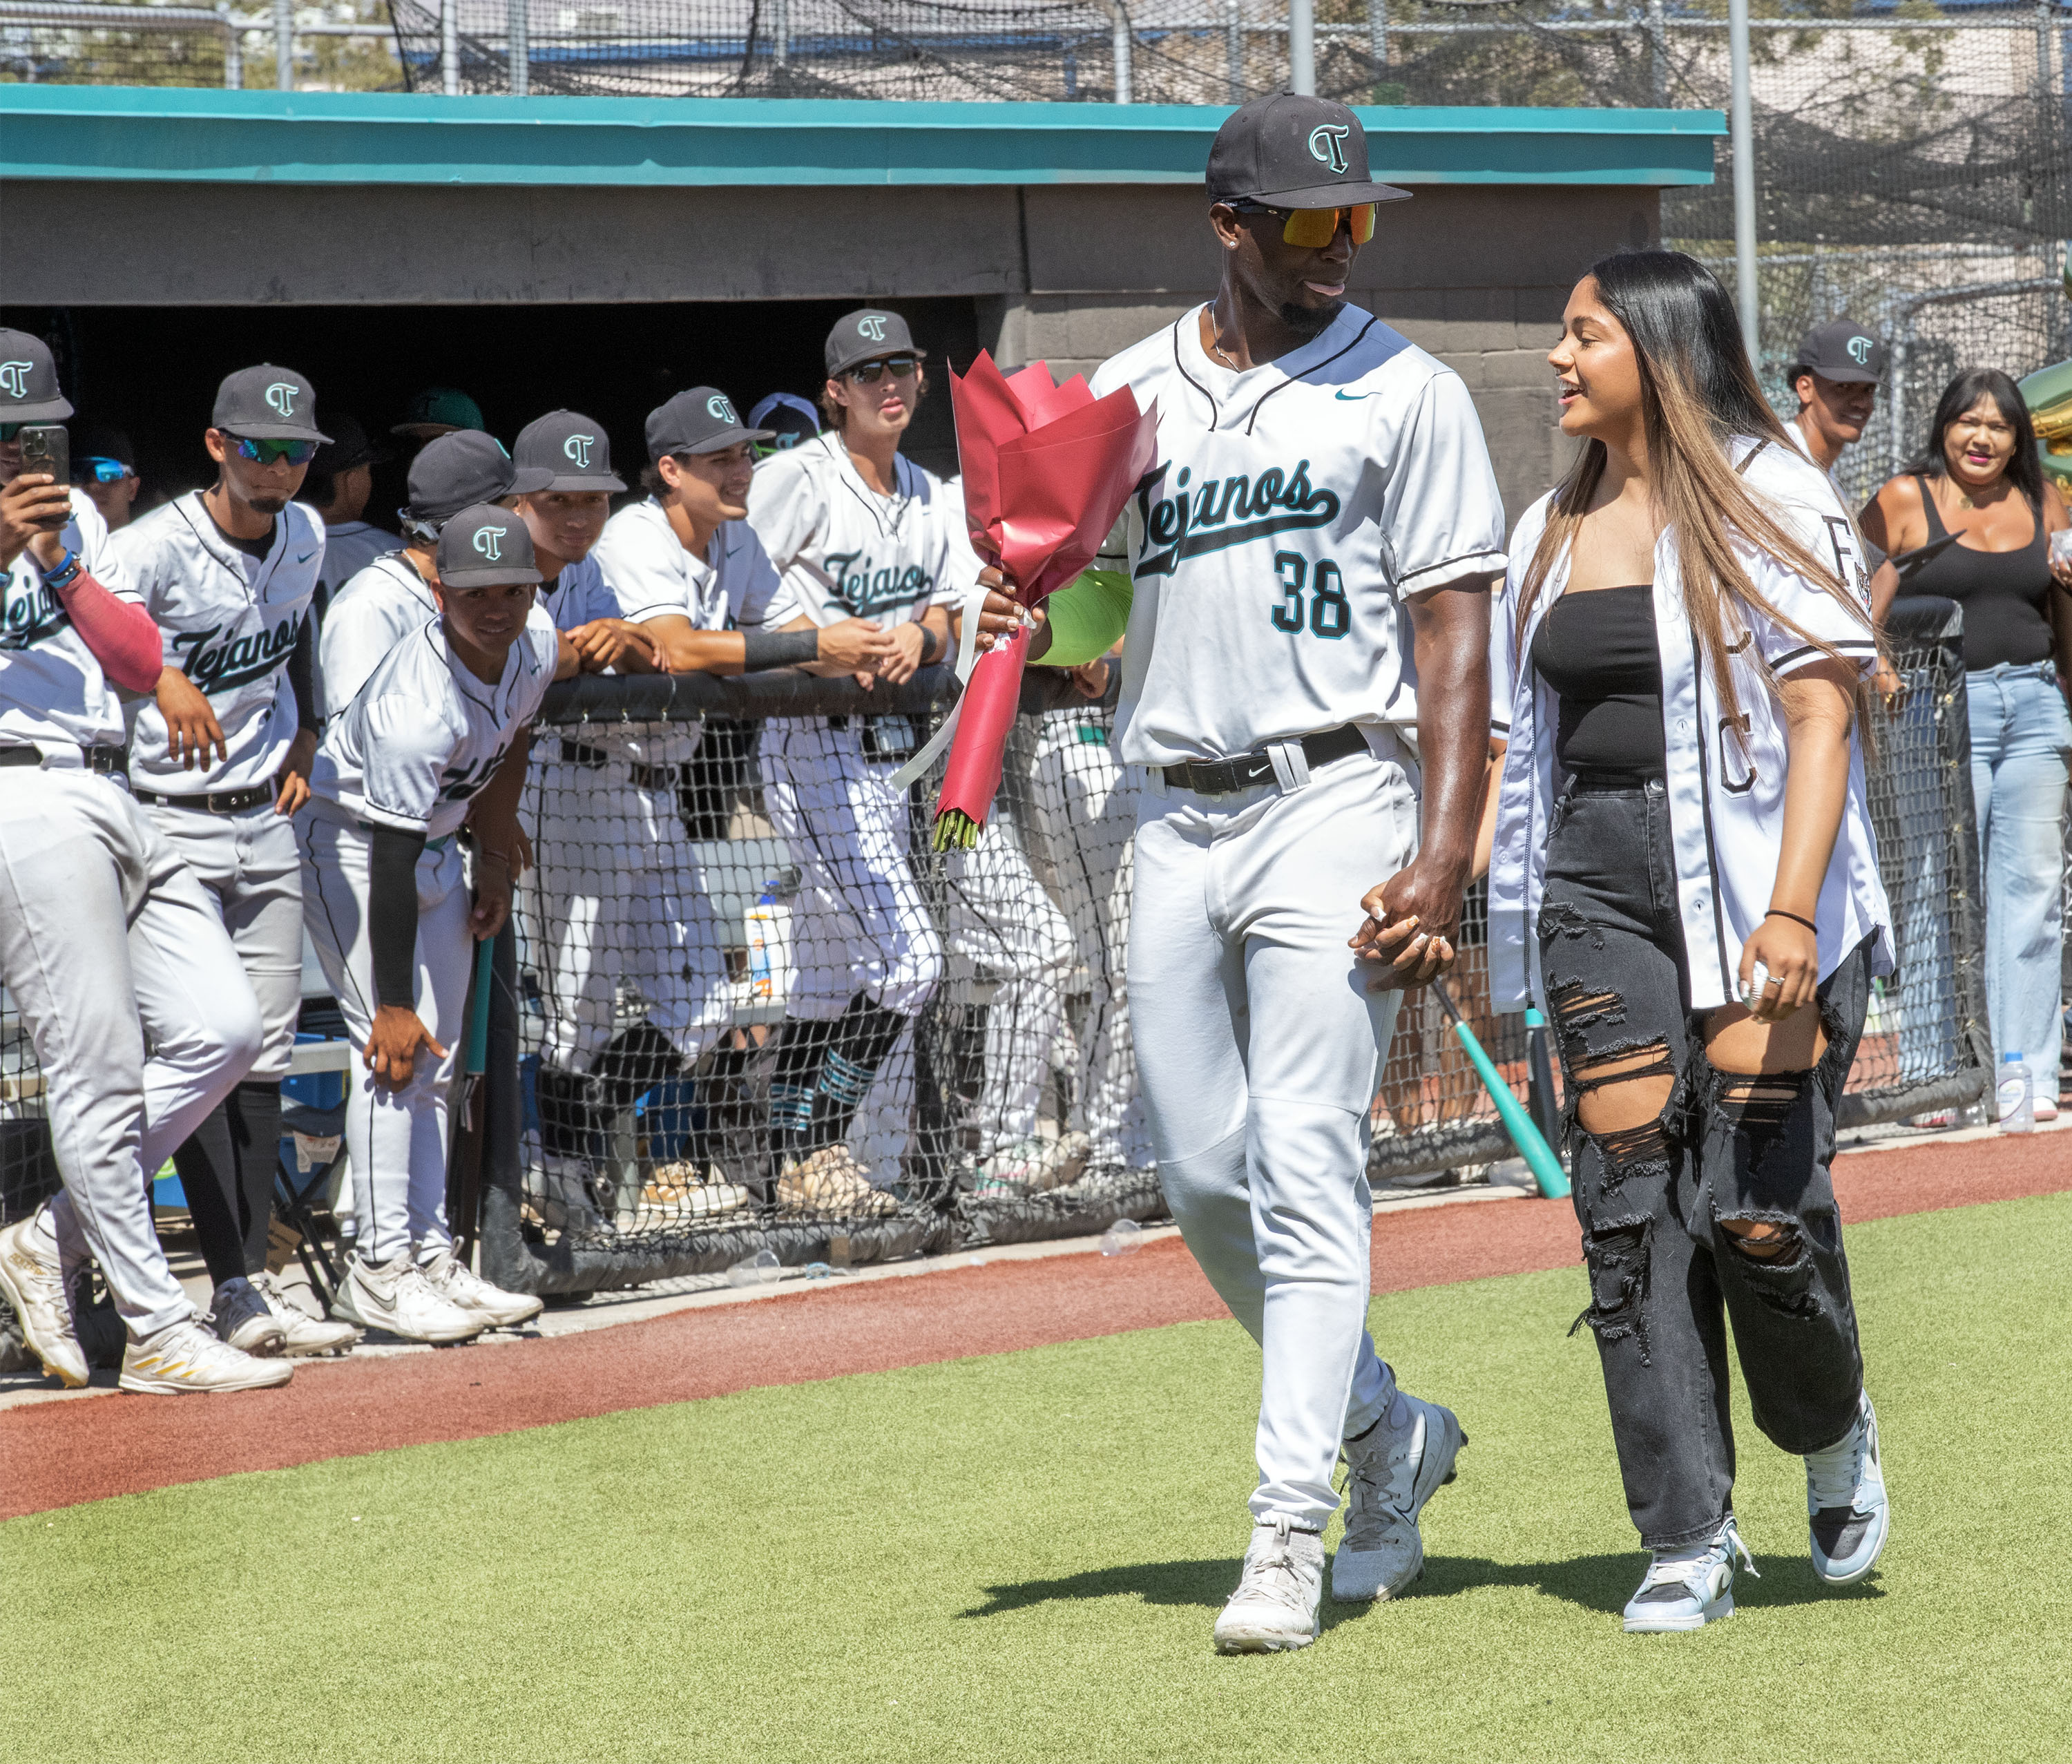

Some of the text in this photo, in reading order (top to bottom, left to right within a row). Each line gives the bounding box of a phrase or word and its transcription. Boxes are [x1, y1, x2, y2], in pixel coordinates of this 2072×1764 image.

[1307, 124, 1350, 175] T
[857, 316, 887, 342] T
[1847, 336, 1874, 365] T
[0, 361, 33, 399] T
[265, 382, 300, 417] T
[707, 395, 736, 424] T
[564, 434, 595, 468] T
[1133, 459, 1341, 581] Tejanos
[472, 526, 507, 561] T
[1271, 550, 1352, 640] 38
